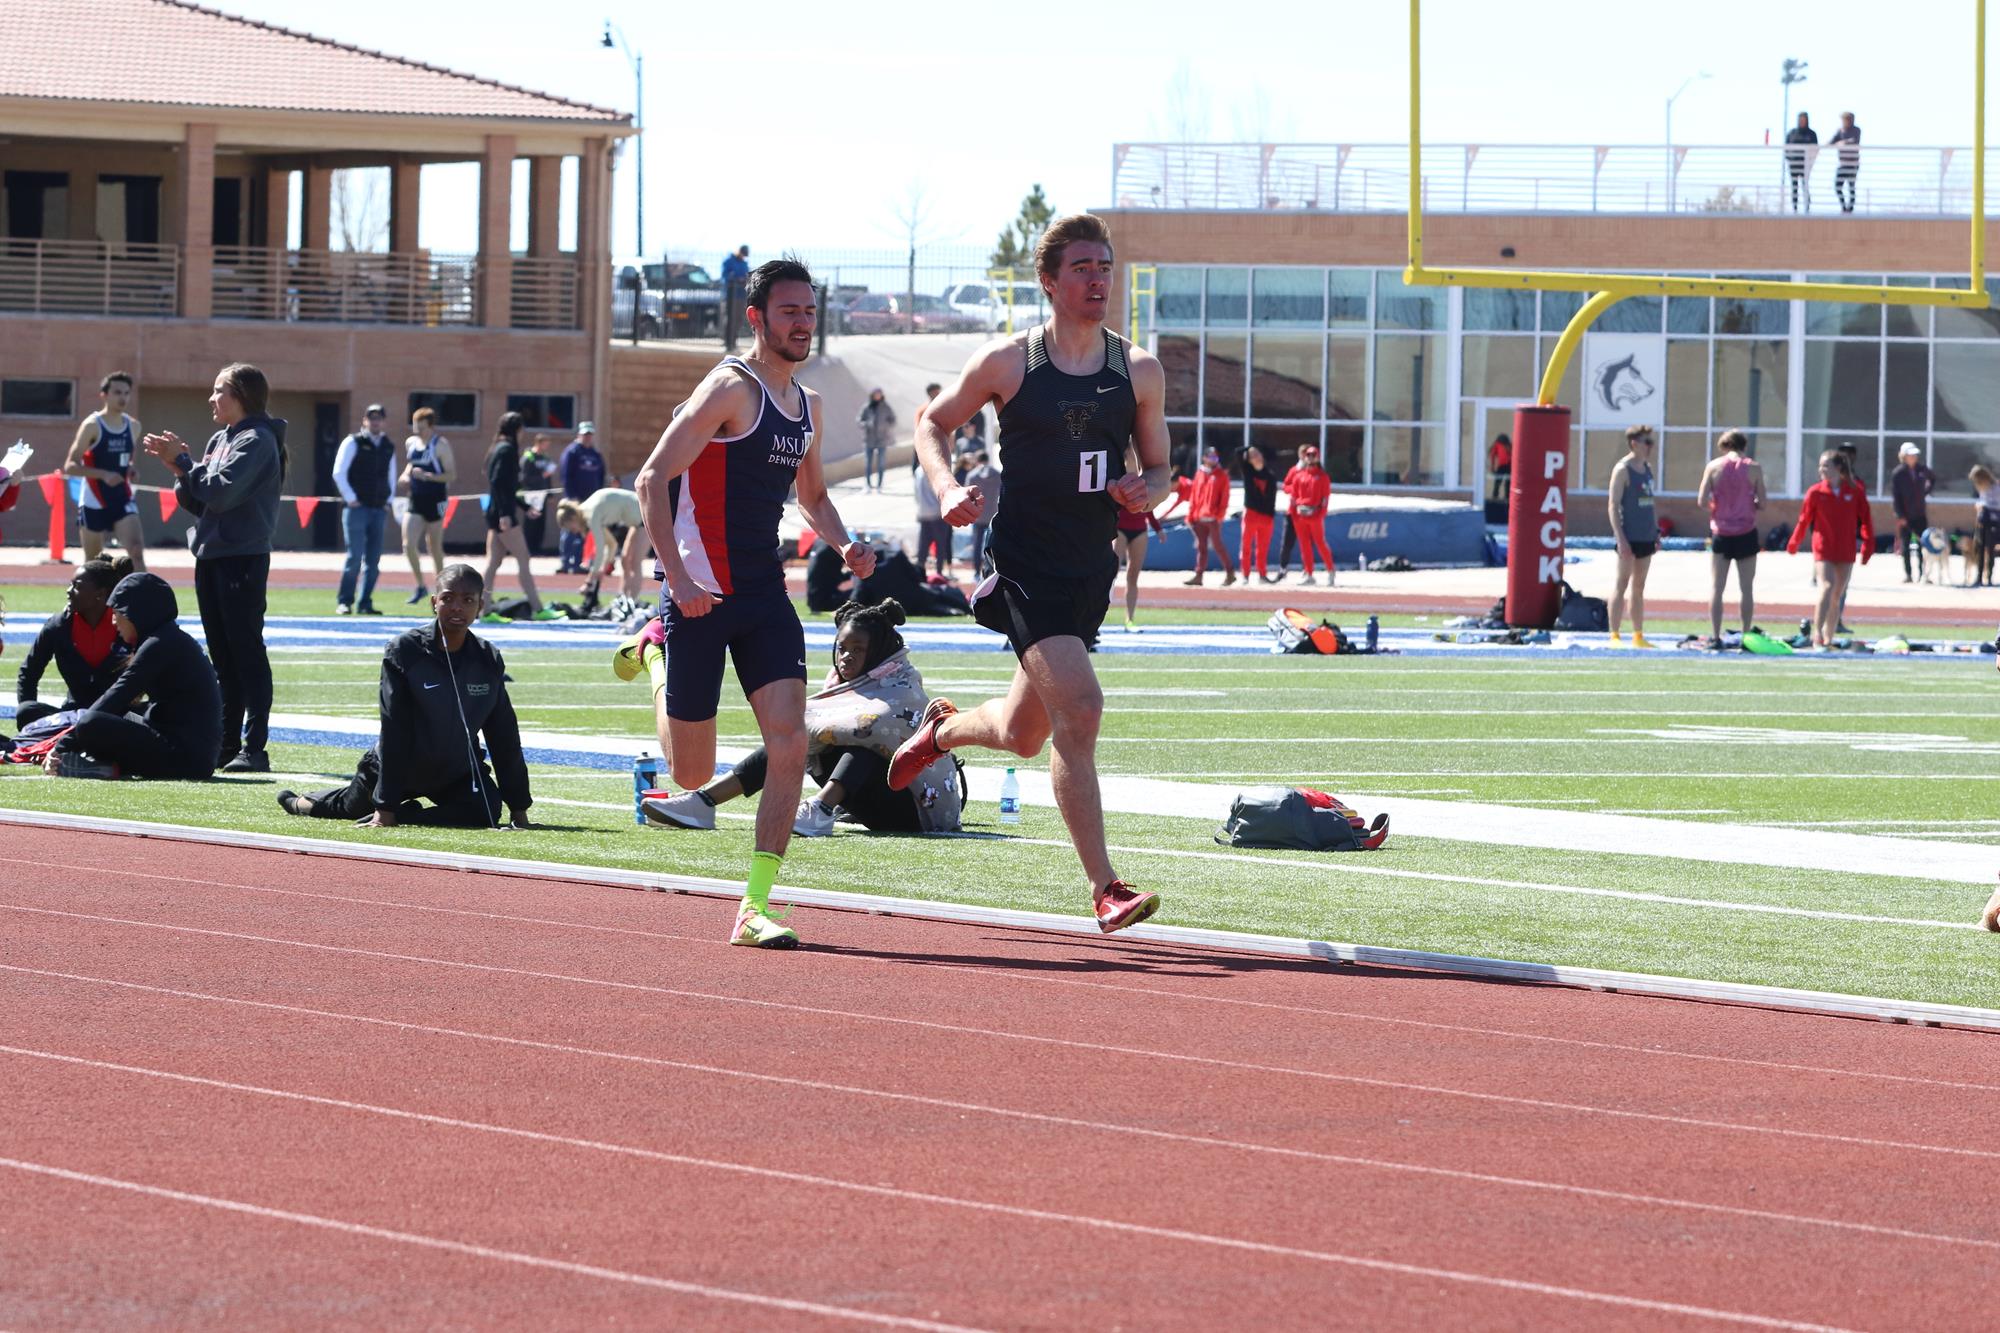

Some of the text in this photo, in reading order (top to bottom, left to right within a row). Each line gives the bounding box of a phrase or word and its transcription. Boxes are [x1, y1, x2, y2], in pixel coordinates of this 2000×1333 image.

[772, 433, 805, 455] MSU
[768, 454, 801, 467] DENVER
[1085, 453, 1098, 489] 1
[1538, 450, 1565, 583] PACK
[1348, 522, 1388, 540] GILL
